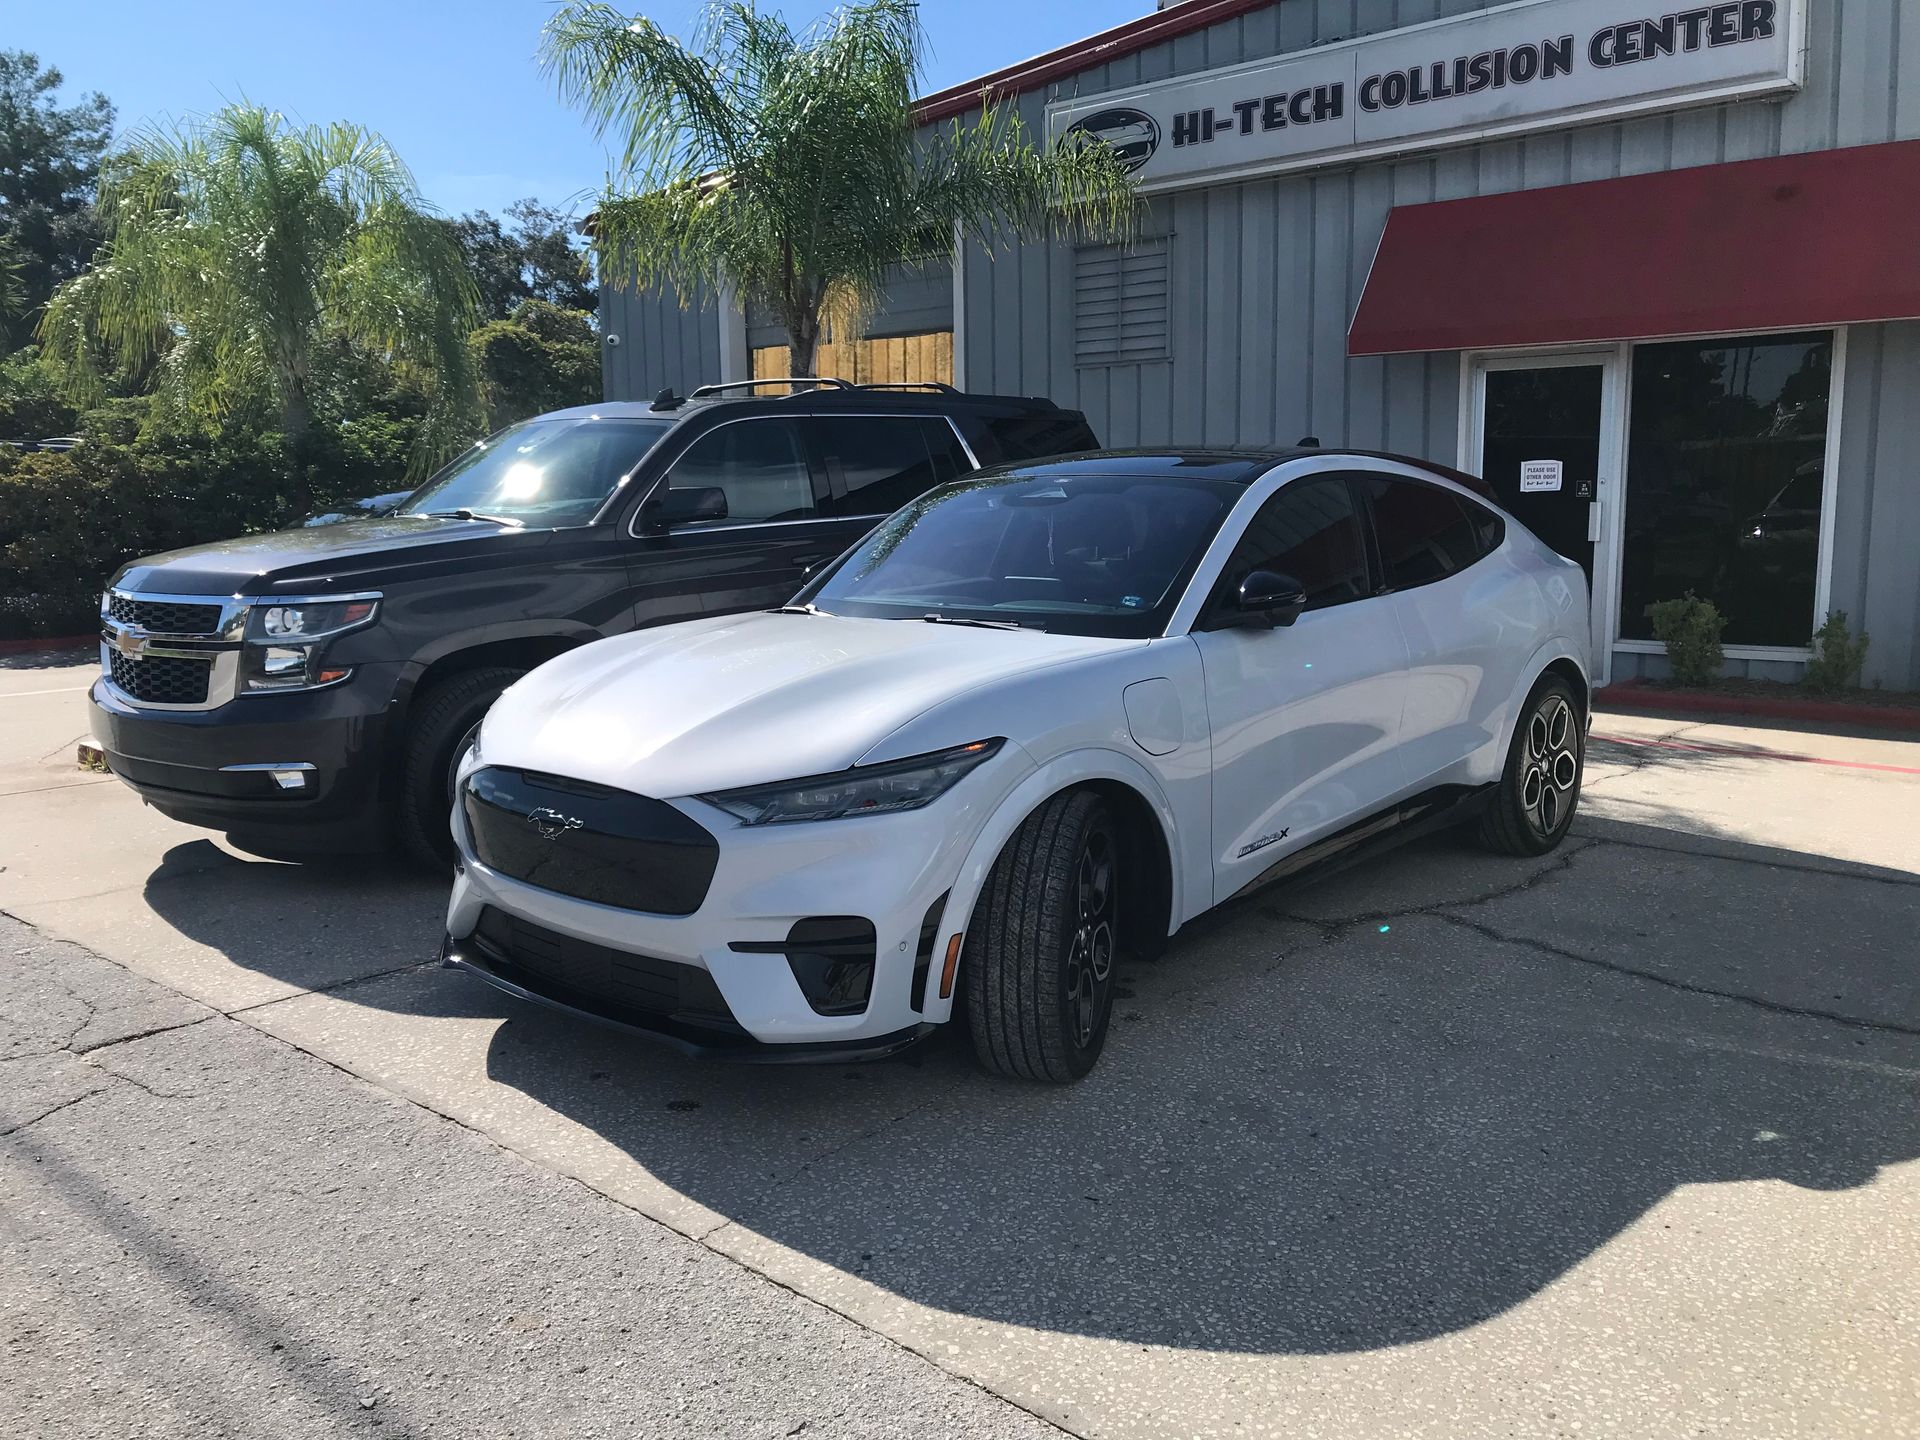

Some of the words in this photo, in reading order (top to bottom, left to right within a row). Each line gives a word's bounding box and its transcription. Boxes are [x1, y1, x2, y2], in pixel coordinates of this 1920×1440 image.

[1172, 82, 1343, 148] HI-TECH
[1359, 35, 1574, 113] COLLISION
[1588, 0, 1776, 68] CENTER
